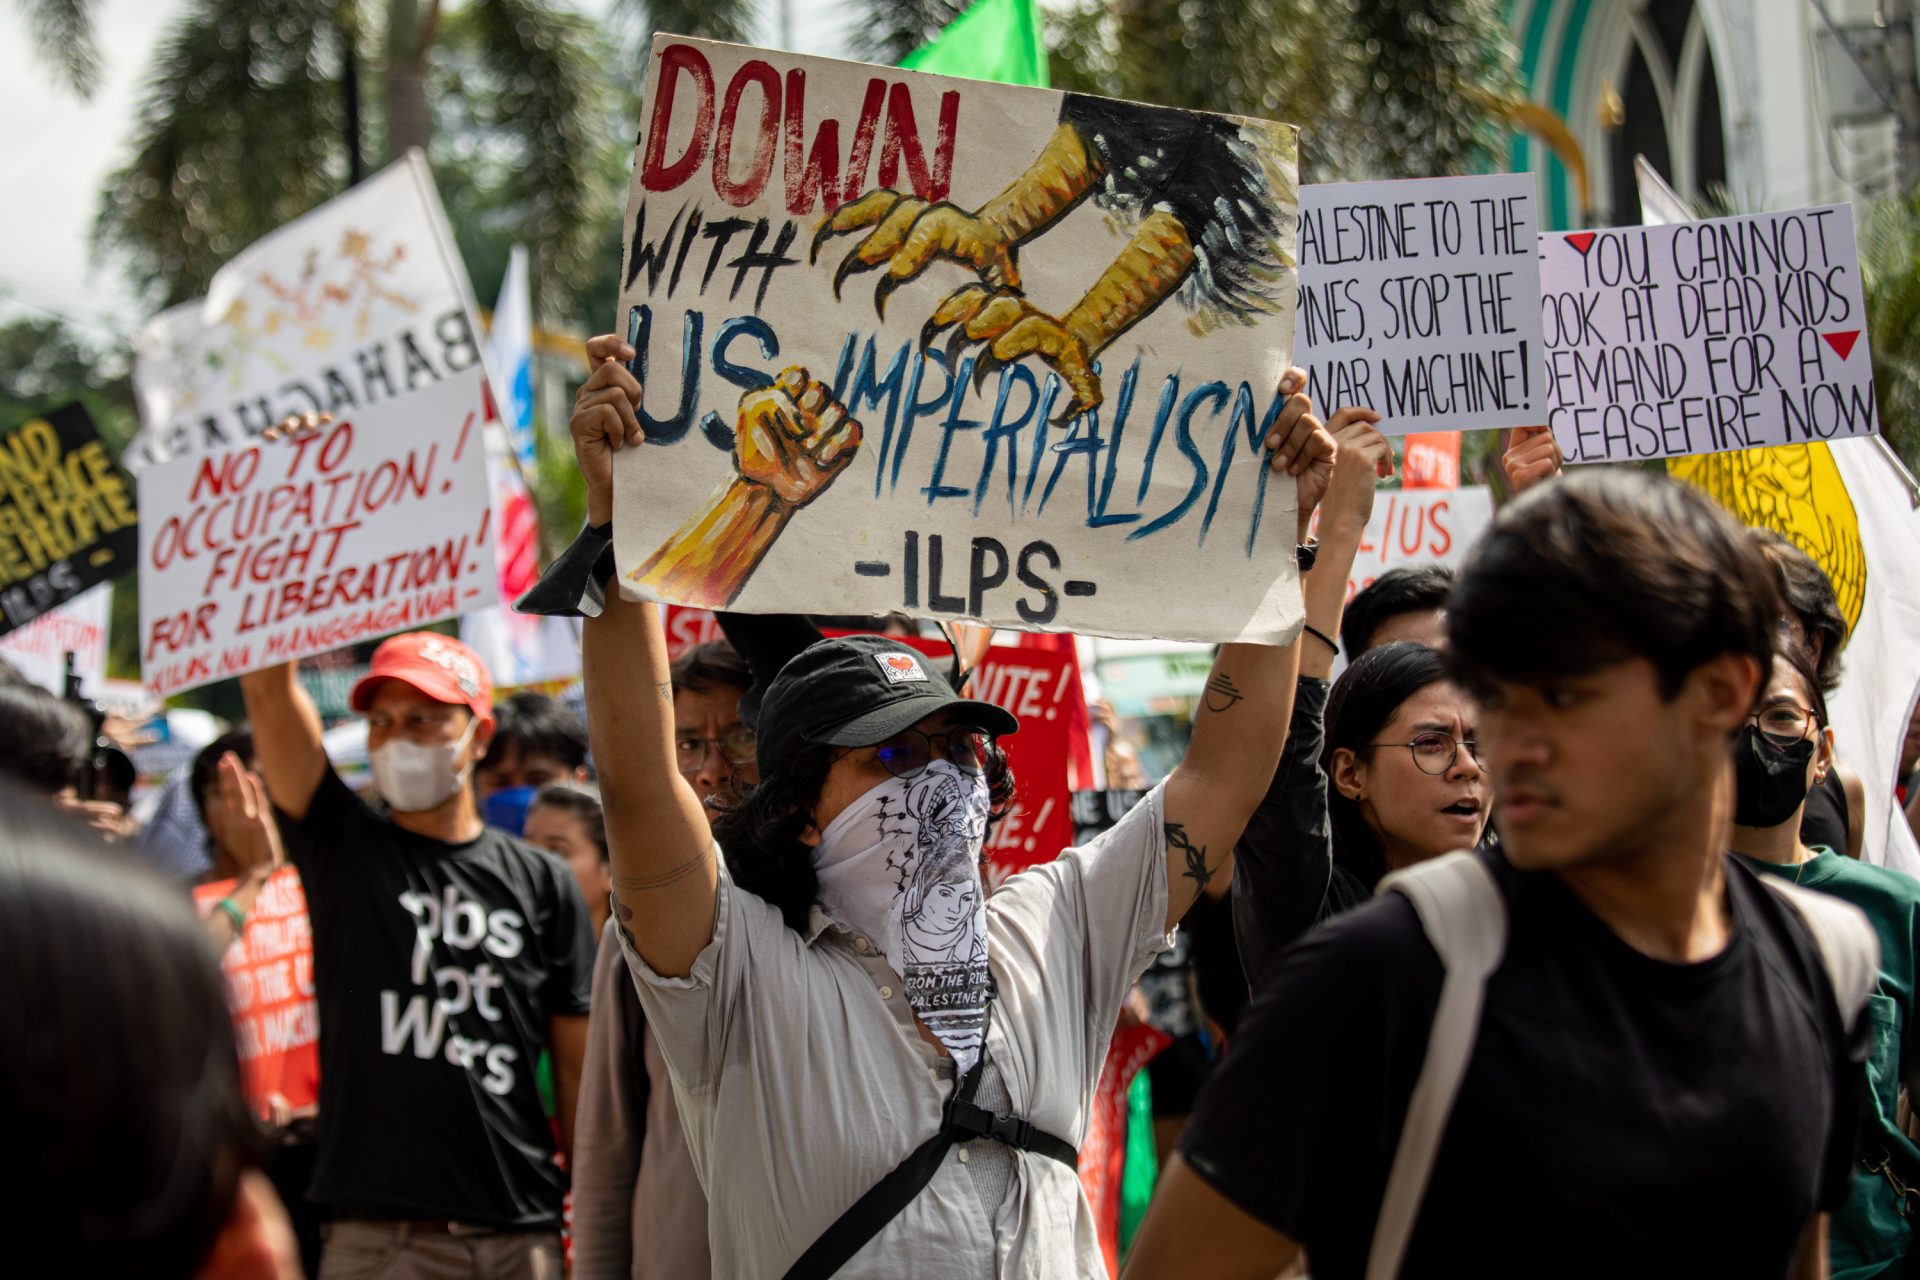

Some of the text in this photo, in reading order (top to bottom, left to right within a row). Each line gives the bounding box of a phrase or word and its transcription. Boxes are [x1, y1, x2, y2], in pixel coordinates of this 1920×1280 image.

[642, 44, 960, 215] DOWN
[625, 199, 799, 312] WITH
[1297, 203, 1418, 265] ALESTINE
[1424, 201, 1460, 256] TO
[1471, 197, 1527, 255] THE
[1564, 232, 1649, 287] YOU
[1672, 210, 1834, 282] CANNOT
[1297, 272, 1516, 349] INES, STOP THE
[1542, 266, 1850, 348] OOK AT DEAD KIDS
[628, 303, 780, 450] US
[1383, 340, 1530, 418] MACHINE!
[1704, 334, 1781, 395] FOR
[1798, 327, 1824, 384] A
[831, 331, 1284, 558] IMPERIALISM
[1550, 379, 1873, 462] CEASEFIRE NOW
[152, 411, 475, 571] OCCUPATION!
[188, 421, 353, 501] NO TO
[146, 602, 217, 661] FOR
[236, 508, 490, 634] LIBERATION!
[203, 520, 362, 597] FIGHT
[968, 663, 1071, 721] NITE!
[910, 990, 977, 1007] PALESTINE
[940, 974, 964, 988] THE
[968, 971, 988, 985] RIVE
